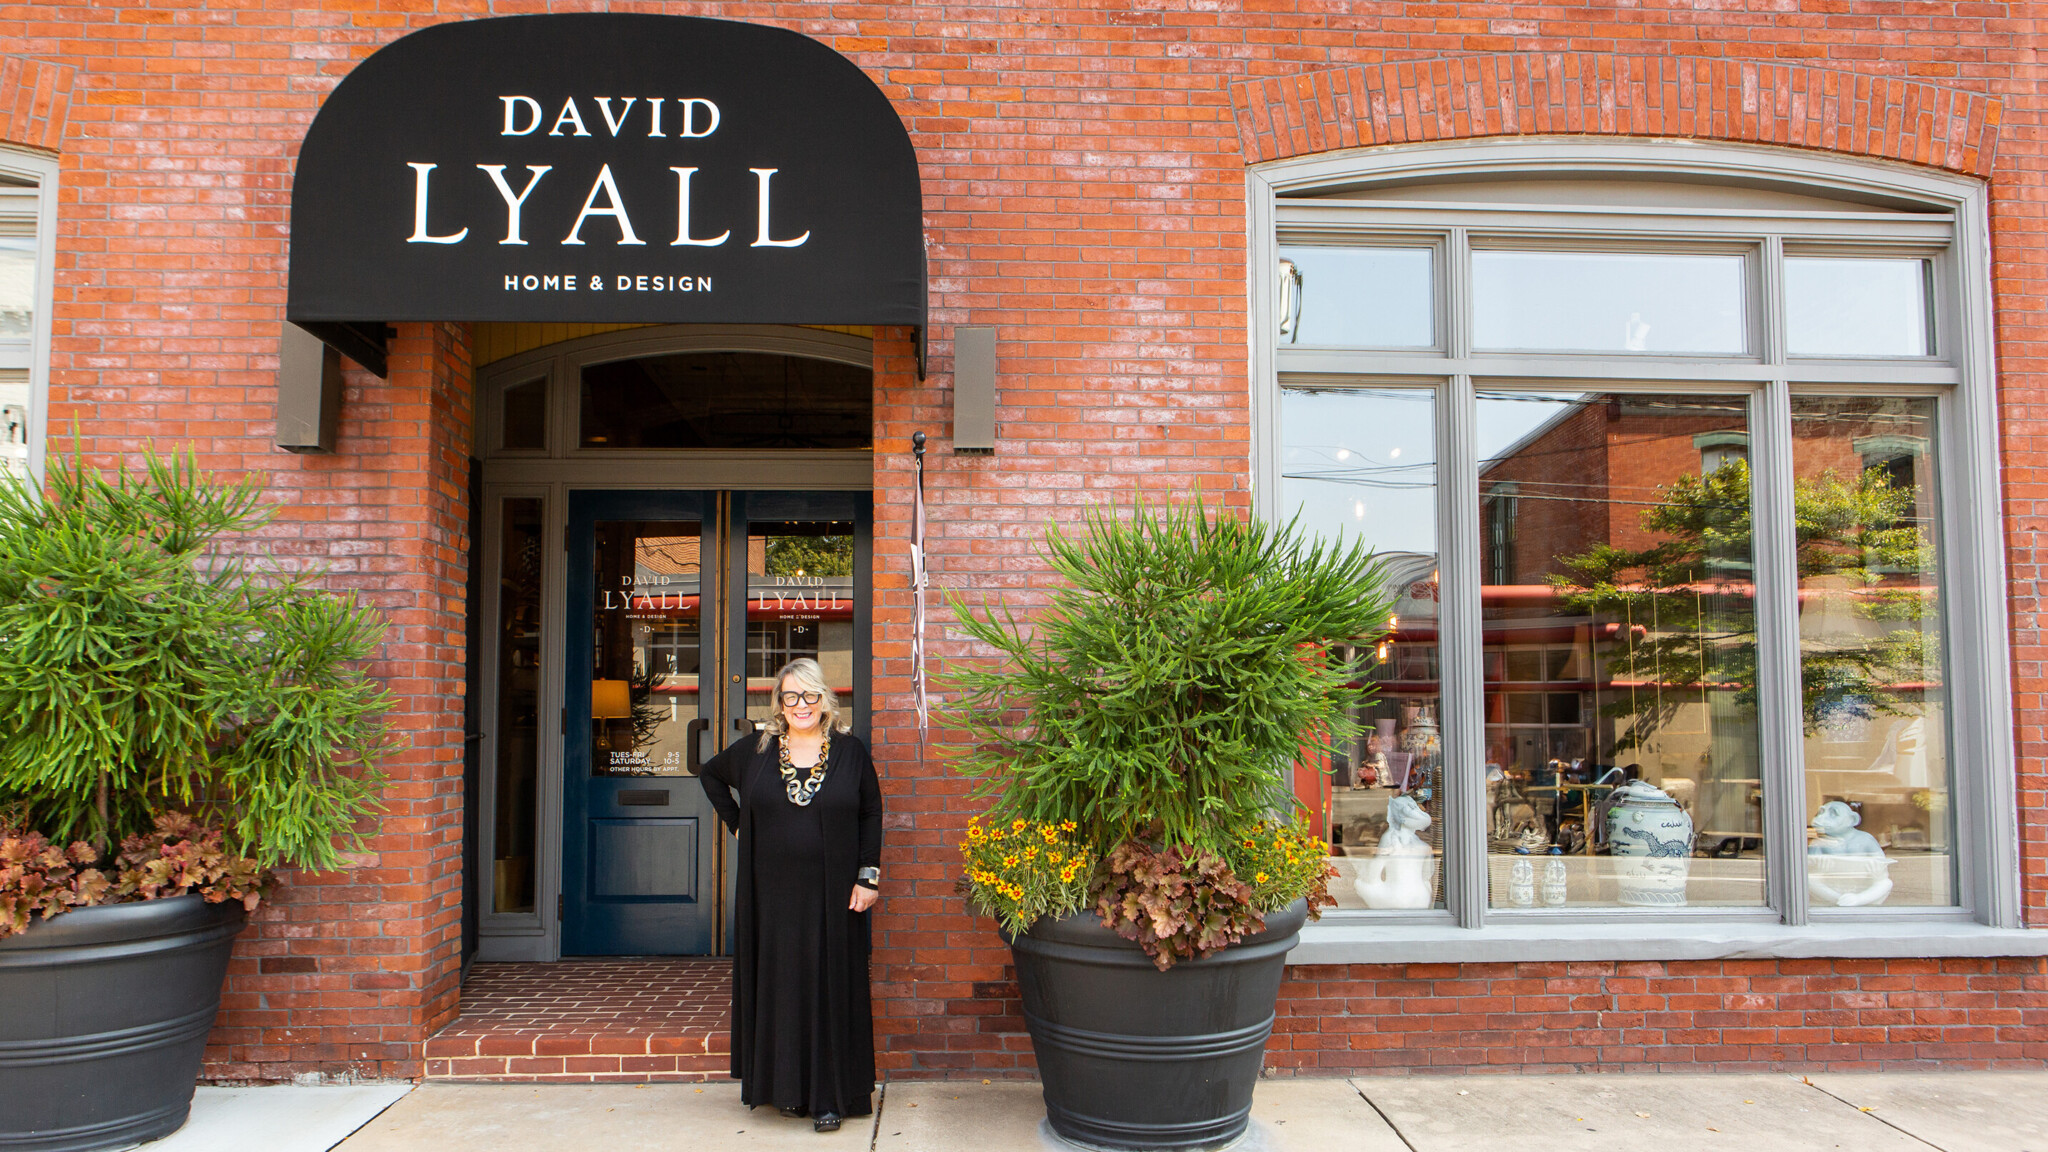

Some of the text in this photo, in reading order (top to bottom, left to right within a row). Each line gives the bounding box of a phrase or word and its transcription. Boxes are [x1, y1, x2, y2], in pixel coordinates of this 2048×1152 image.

[498, 95, 721, 138] DAVID
[405, 161, 811, 248] LYALL
[504, 274, 712, 292] HOME & DESIGN
[622, 576, 670, 586] DAVID
[775, 576, 824, 586] DAVID
[604, 591, 691, 610] LYALL
[758, 591, 845, 610] LYALL
